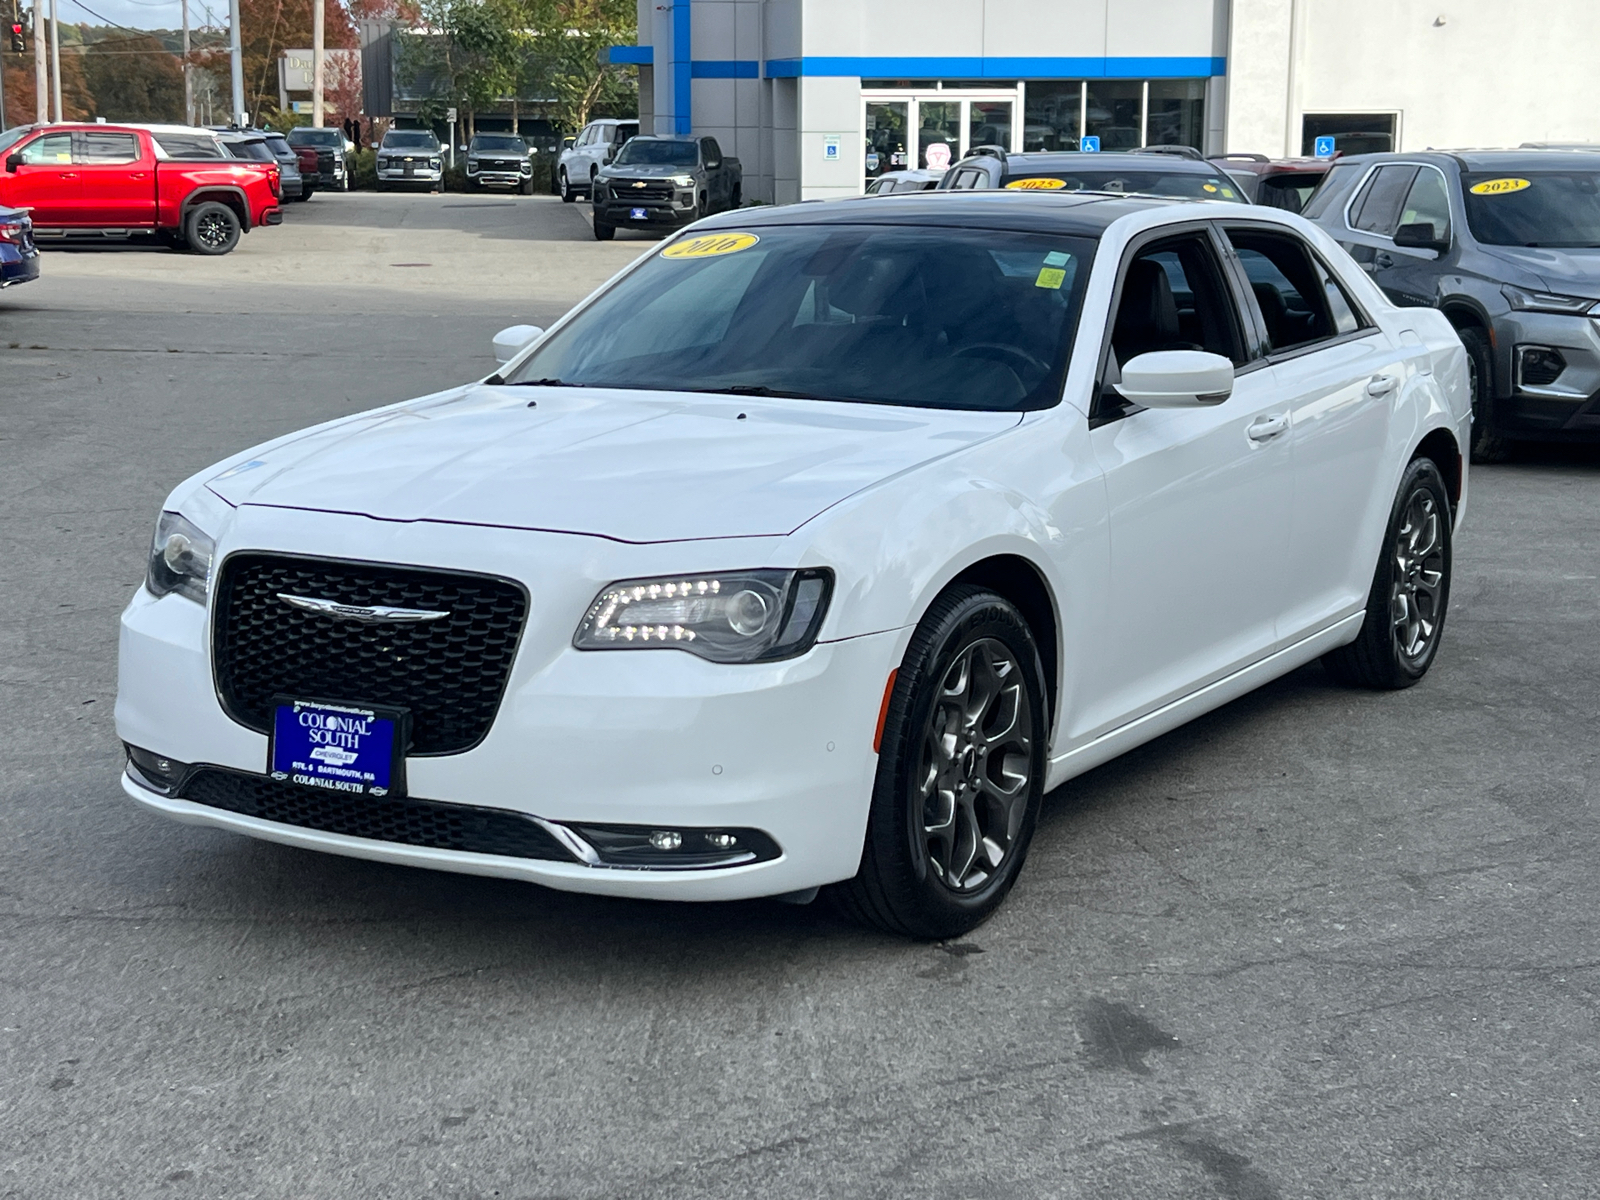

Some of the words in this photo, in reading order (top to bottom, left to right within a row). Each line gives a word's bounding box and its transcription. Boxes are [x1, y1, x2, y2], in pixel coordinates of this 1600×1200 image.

[1483, 180, 1519, 193] 2023
[669, 236, 749, 256] 2016
[299, 712, 371, 735] COLONIAL
[309, 728, 359, 749] SOUTH
[314, 750, 353, 761] CHEVROLET
[293, 773, 334, 789] COLONIAL
[335, 781, 363, 794] SOUTH
